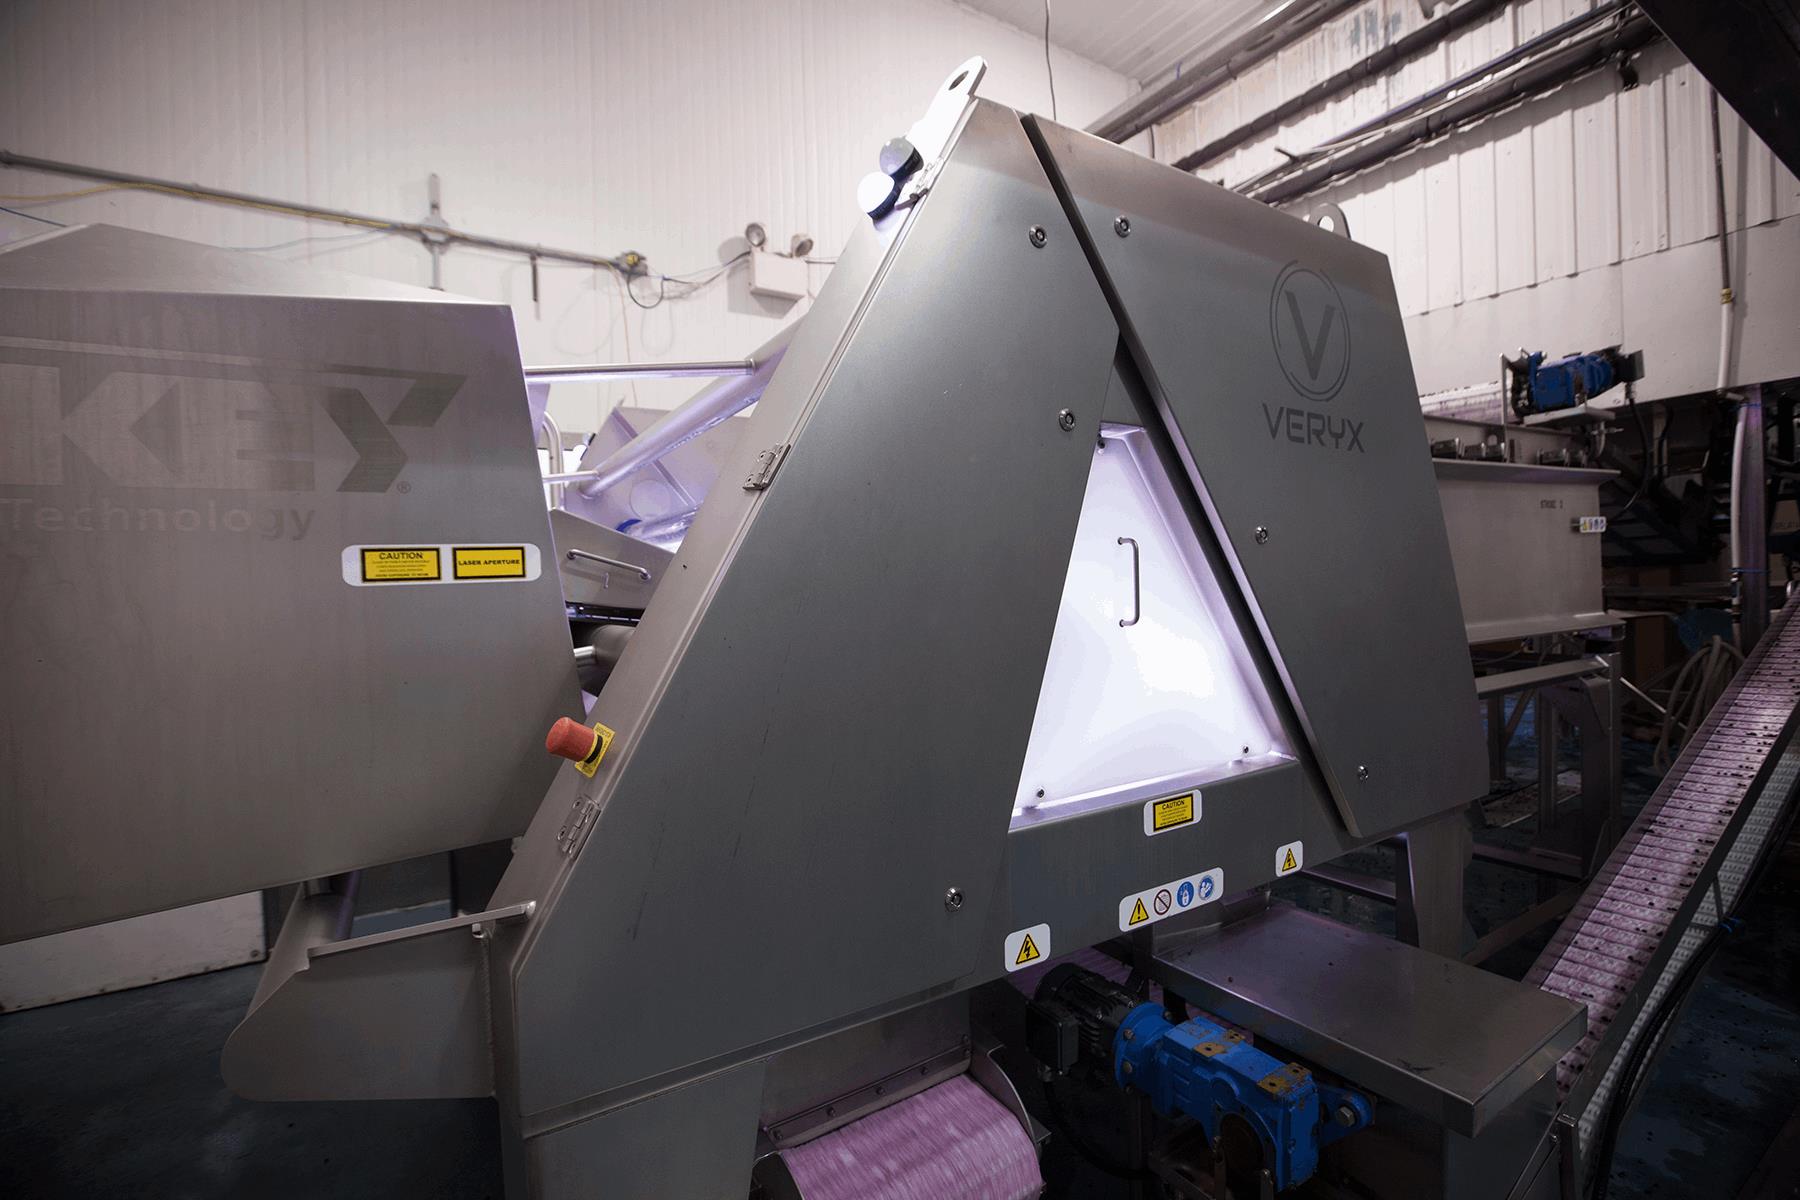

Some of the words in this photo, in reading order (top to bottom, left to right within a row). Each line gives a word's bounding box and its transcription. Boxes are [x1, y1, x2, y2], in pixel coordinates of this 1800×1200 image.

[0, 340, 468, 493] KEY
[1262, 403, 1365, 453] VERYX
[0, 498, 316, 541] Technology
[379, 552, 424, 560] CAUTION
[1162, 800, 1185, 810] CAUTION
